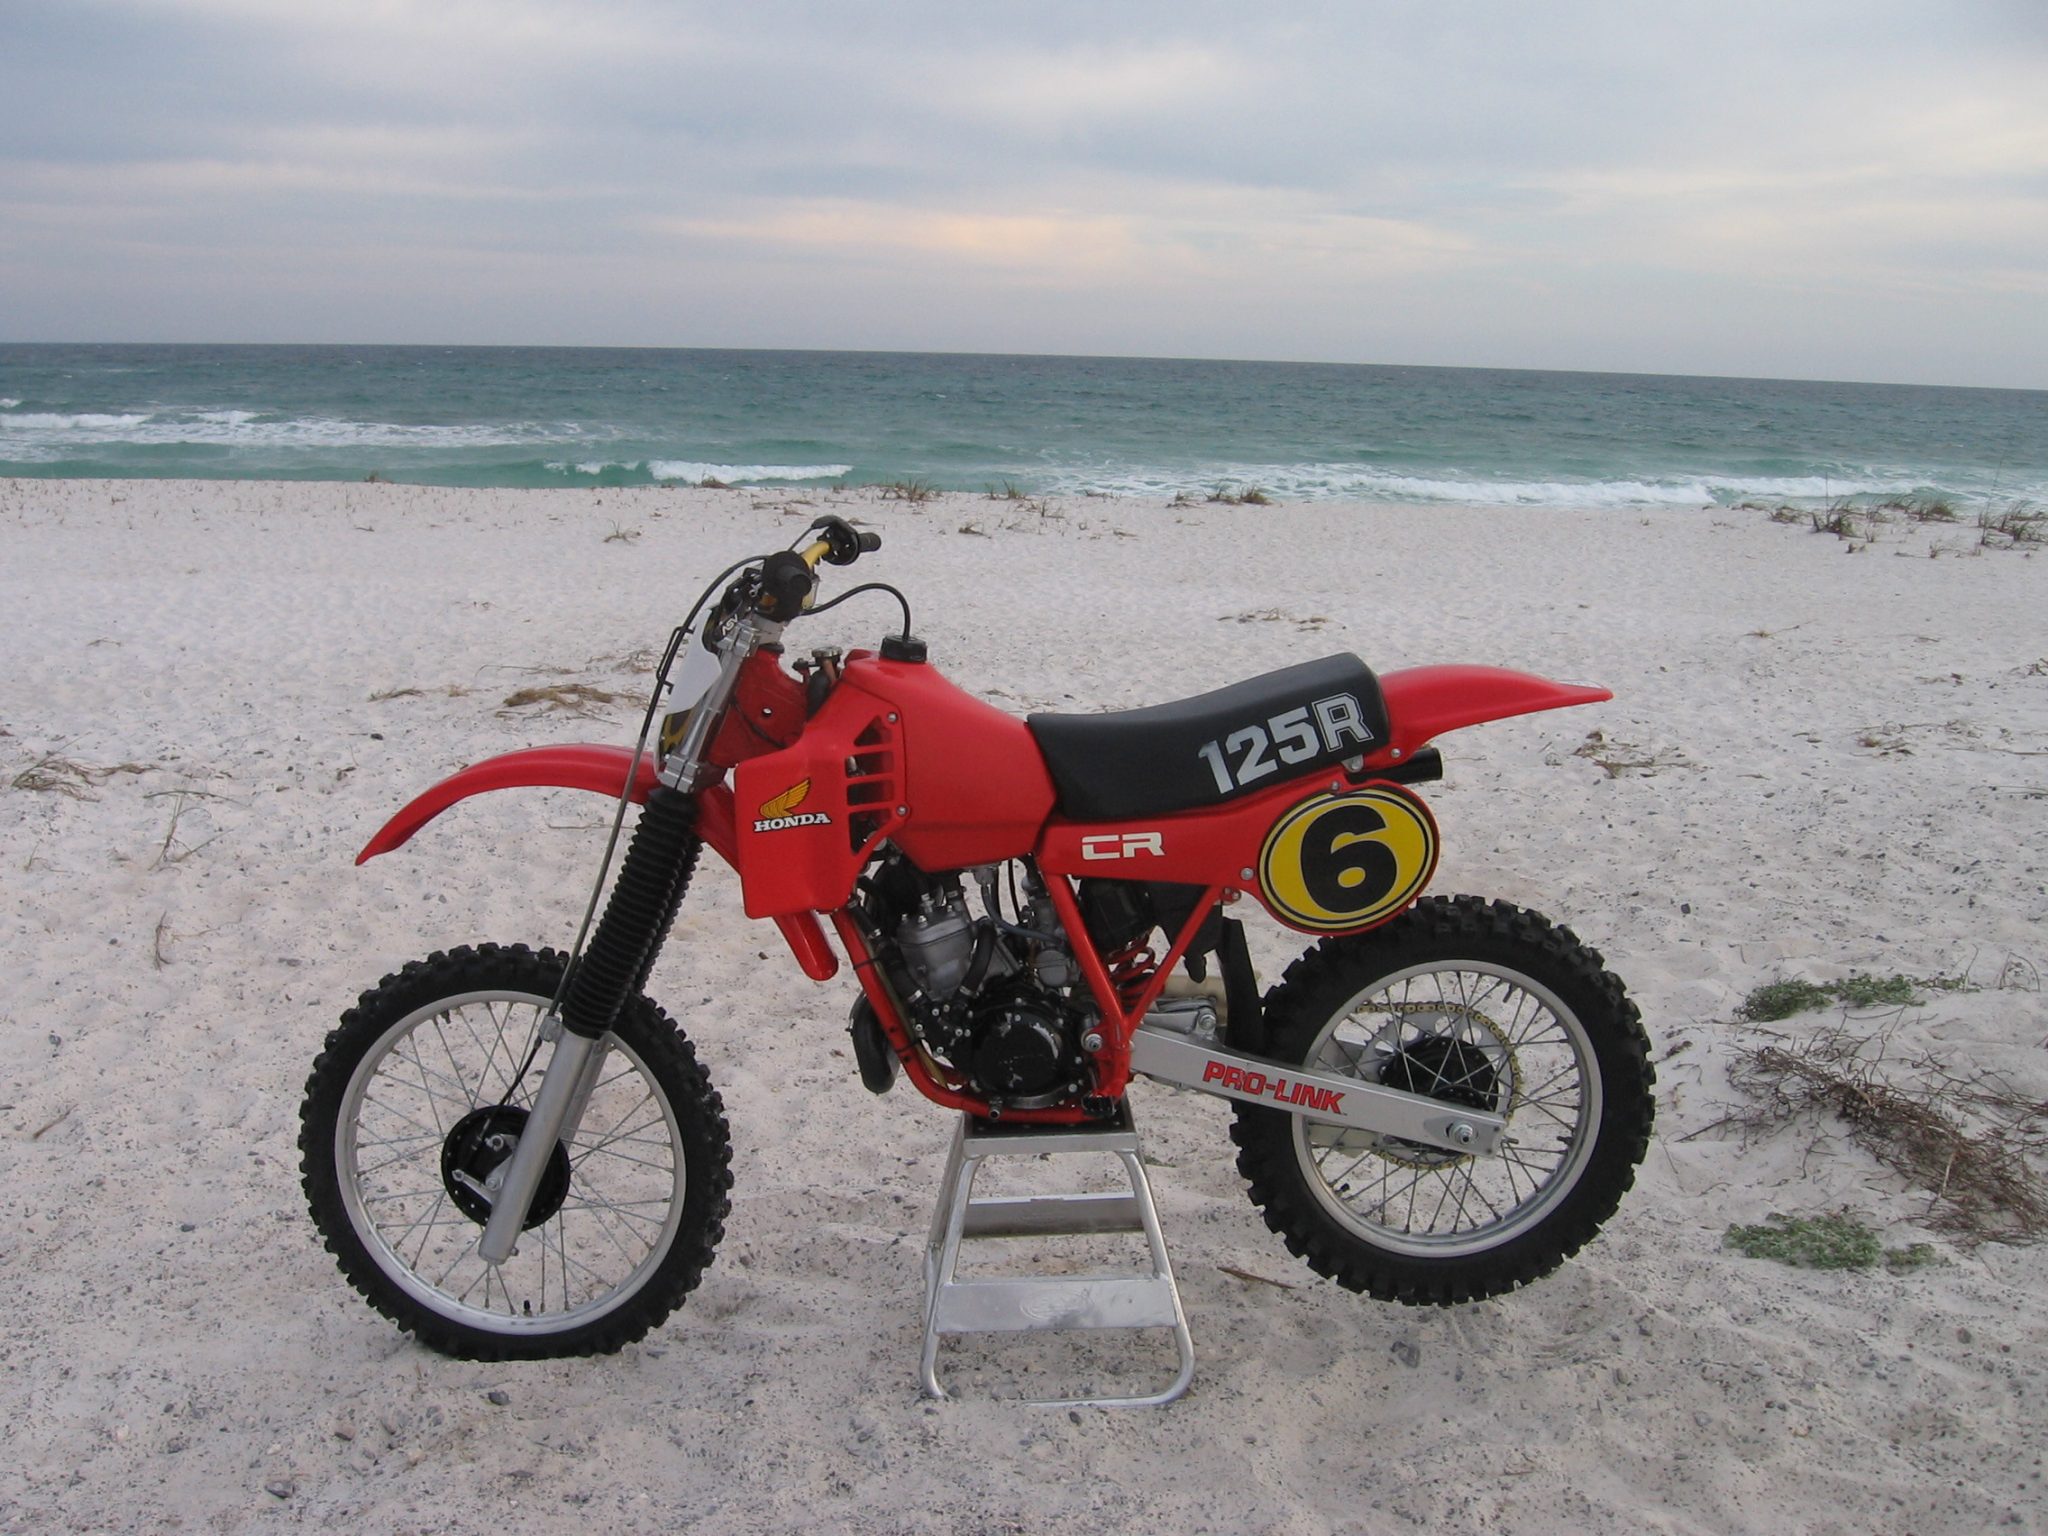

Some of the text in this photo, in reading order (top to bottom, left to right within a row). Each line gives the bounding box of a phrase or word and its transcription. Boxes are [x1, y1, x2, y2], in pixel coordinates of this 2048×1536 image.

[1198, 692, 1375, 794] 125R
[753, 813, 831, 832] HONDA
[1082, 831, 1165, 860] CR
[1300, 804, 1397, 913] 6
[1202, 1060, 1345, 1114] PRO-LINK
